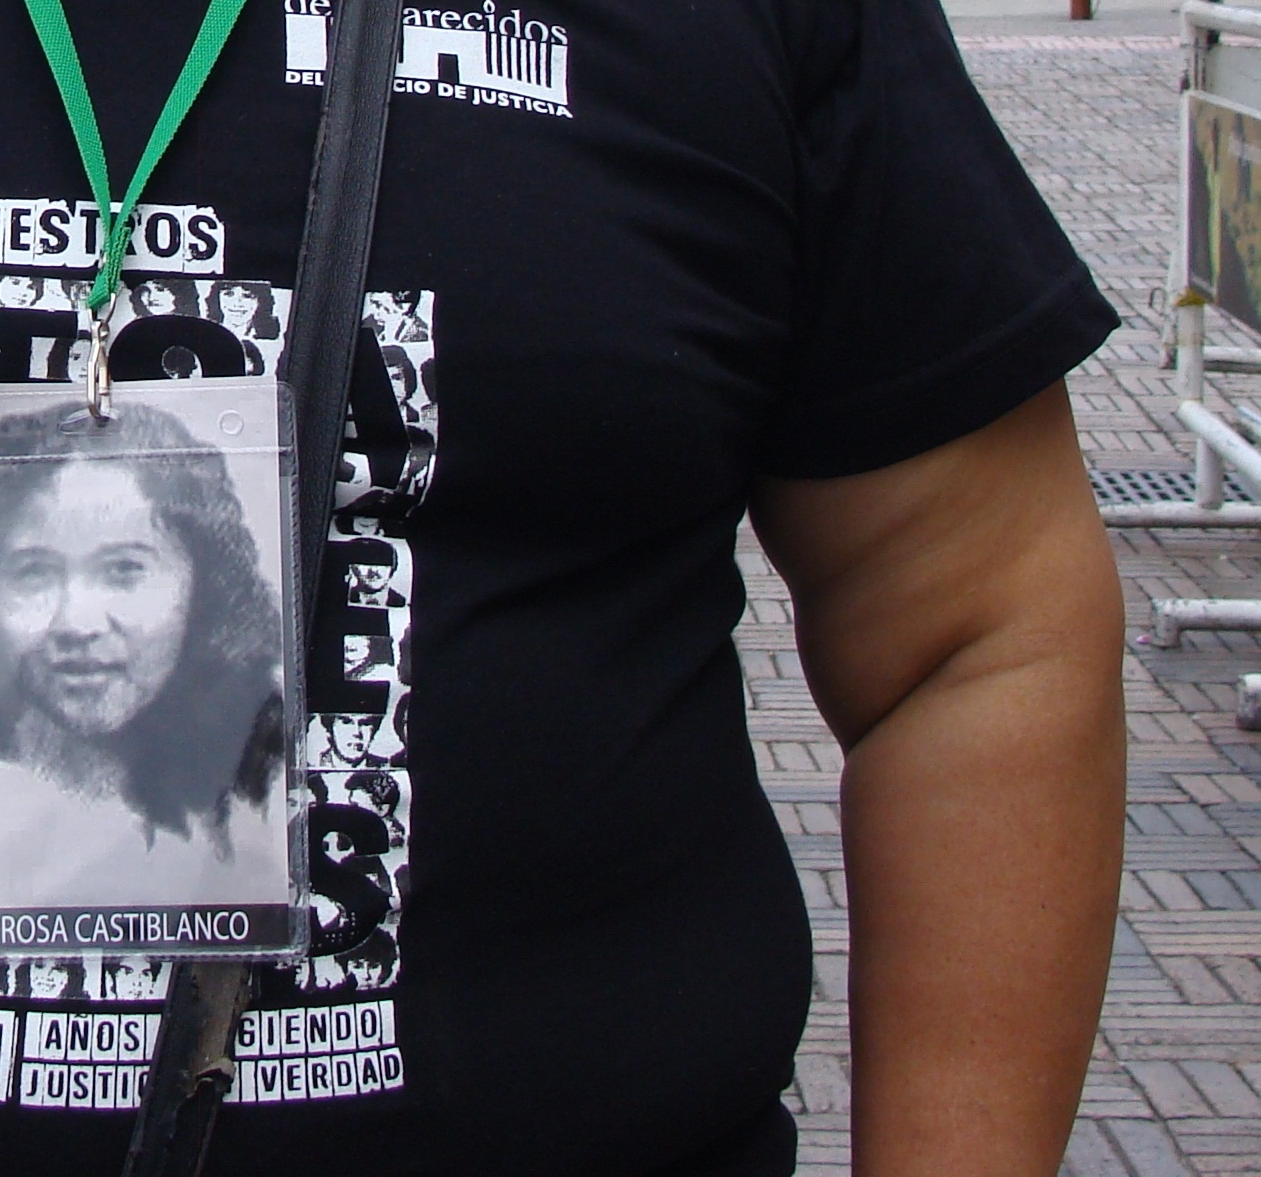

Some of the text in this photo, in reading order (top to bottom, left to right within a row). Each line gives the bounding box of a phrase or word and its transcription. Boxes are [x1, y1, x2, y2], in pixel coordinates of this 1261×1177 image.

[285, 71, 325, 86] DEL
[438, 82, 467, 99] DE
[472, 88, 573, 118] JUSTICIA
[1, 914, 68, 943] ROSA
[75, 910, 249, 941] CASTIBLANCO
[45, 1013, 139, 1052] AÑOS
[260, 1054, 400, 1092] VERDAD
